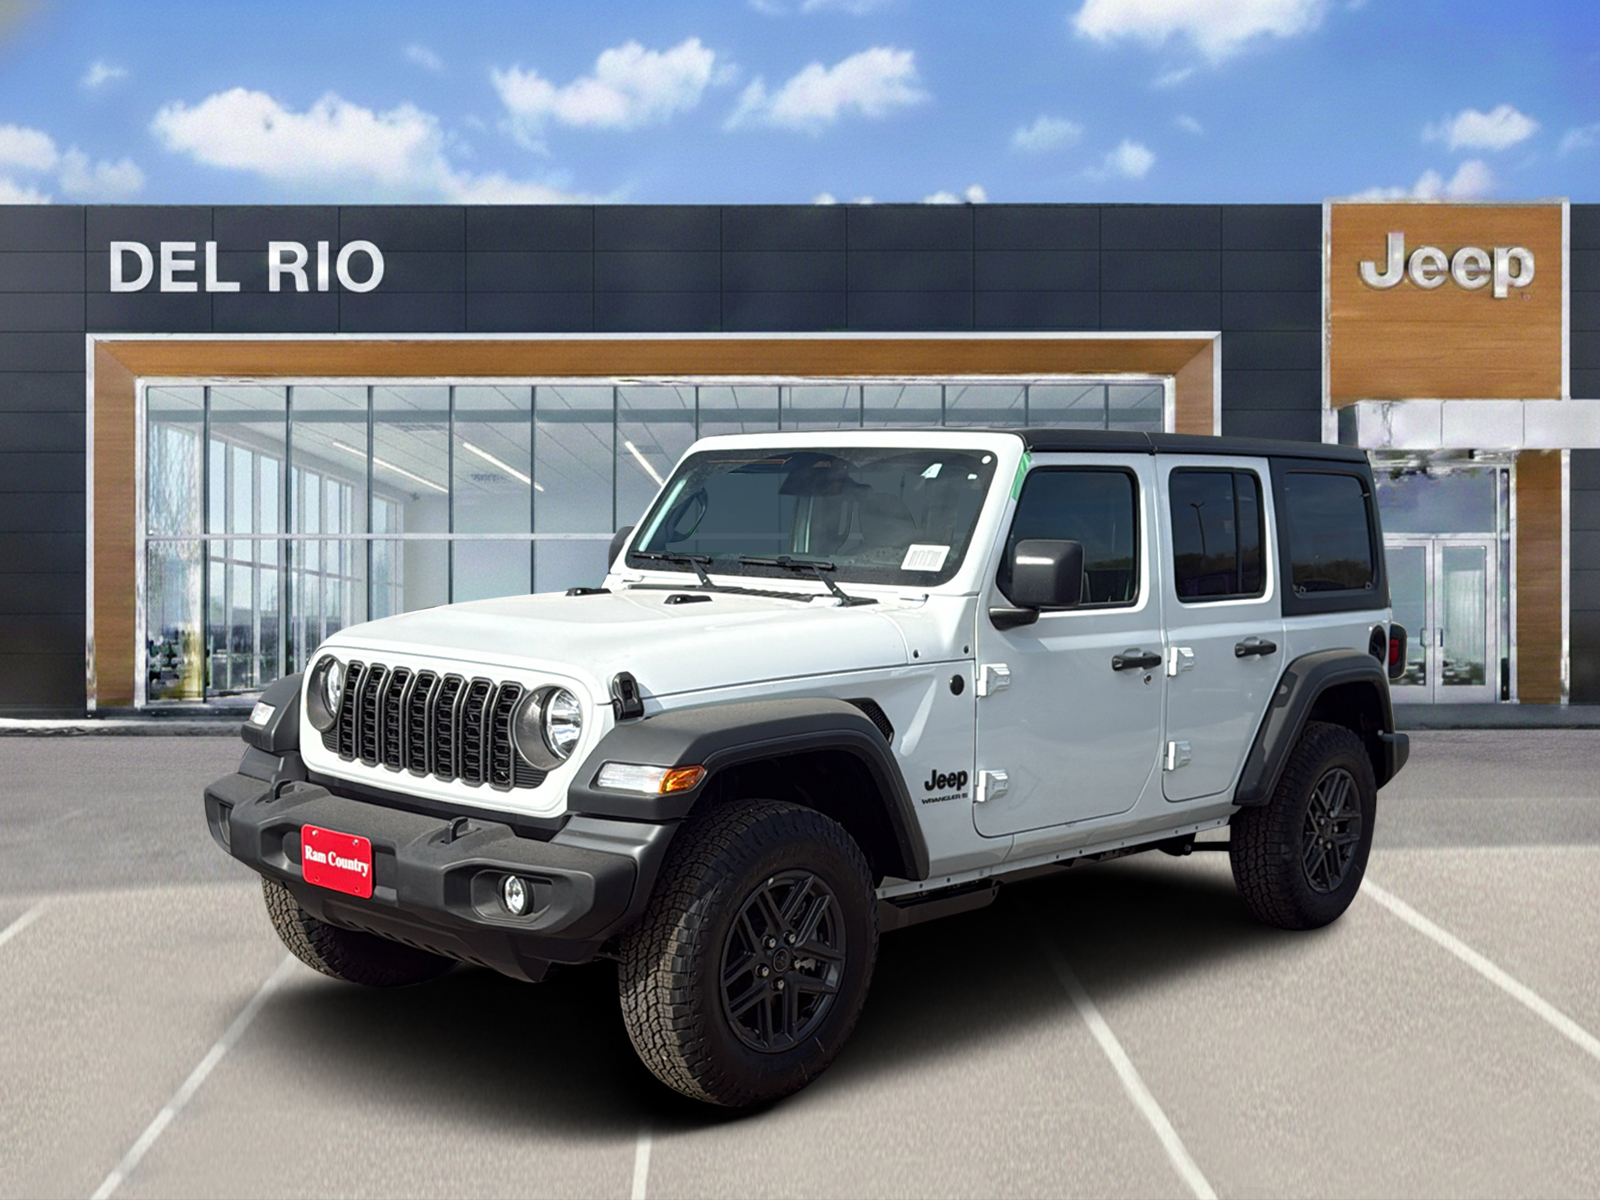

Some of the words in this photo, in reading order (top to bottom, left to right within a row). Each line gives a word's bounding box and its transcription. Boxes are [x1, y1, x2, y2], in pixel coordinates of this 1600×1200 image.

[109, 240, 241, 293] DEL
[268, 239, 386, 293] RIO
[1359, 231, 1536, 299] Jeep
[924, 769, 968, 792] Jeep
[921, 793, 961, 805] WRANGLER
[304, 844, 327, 864] Ram
[327, 850, 370, 878] Country
